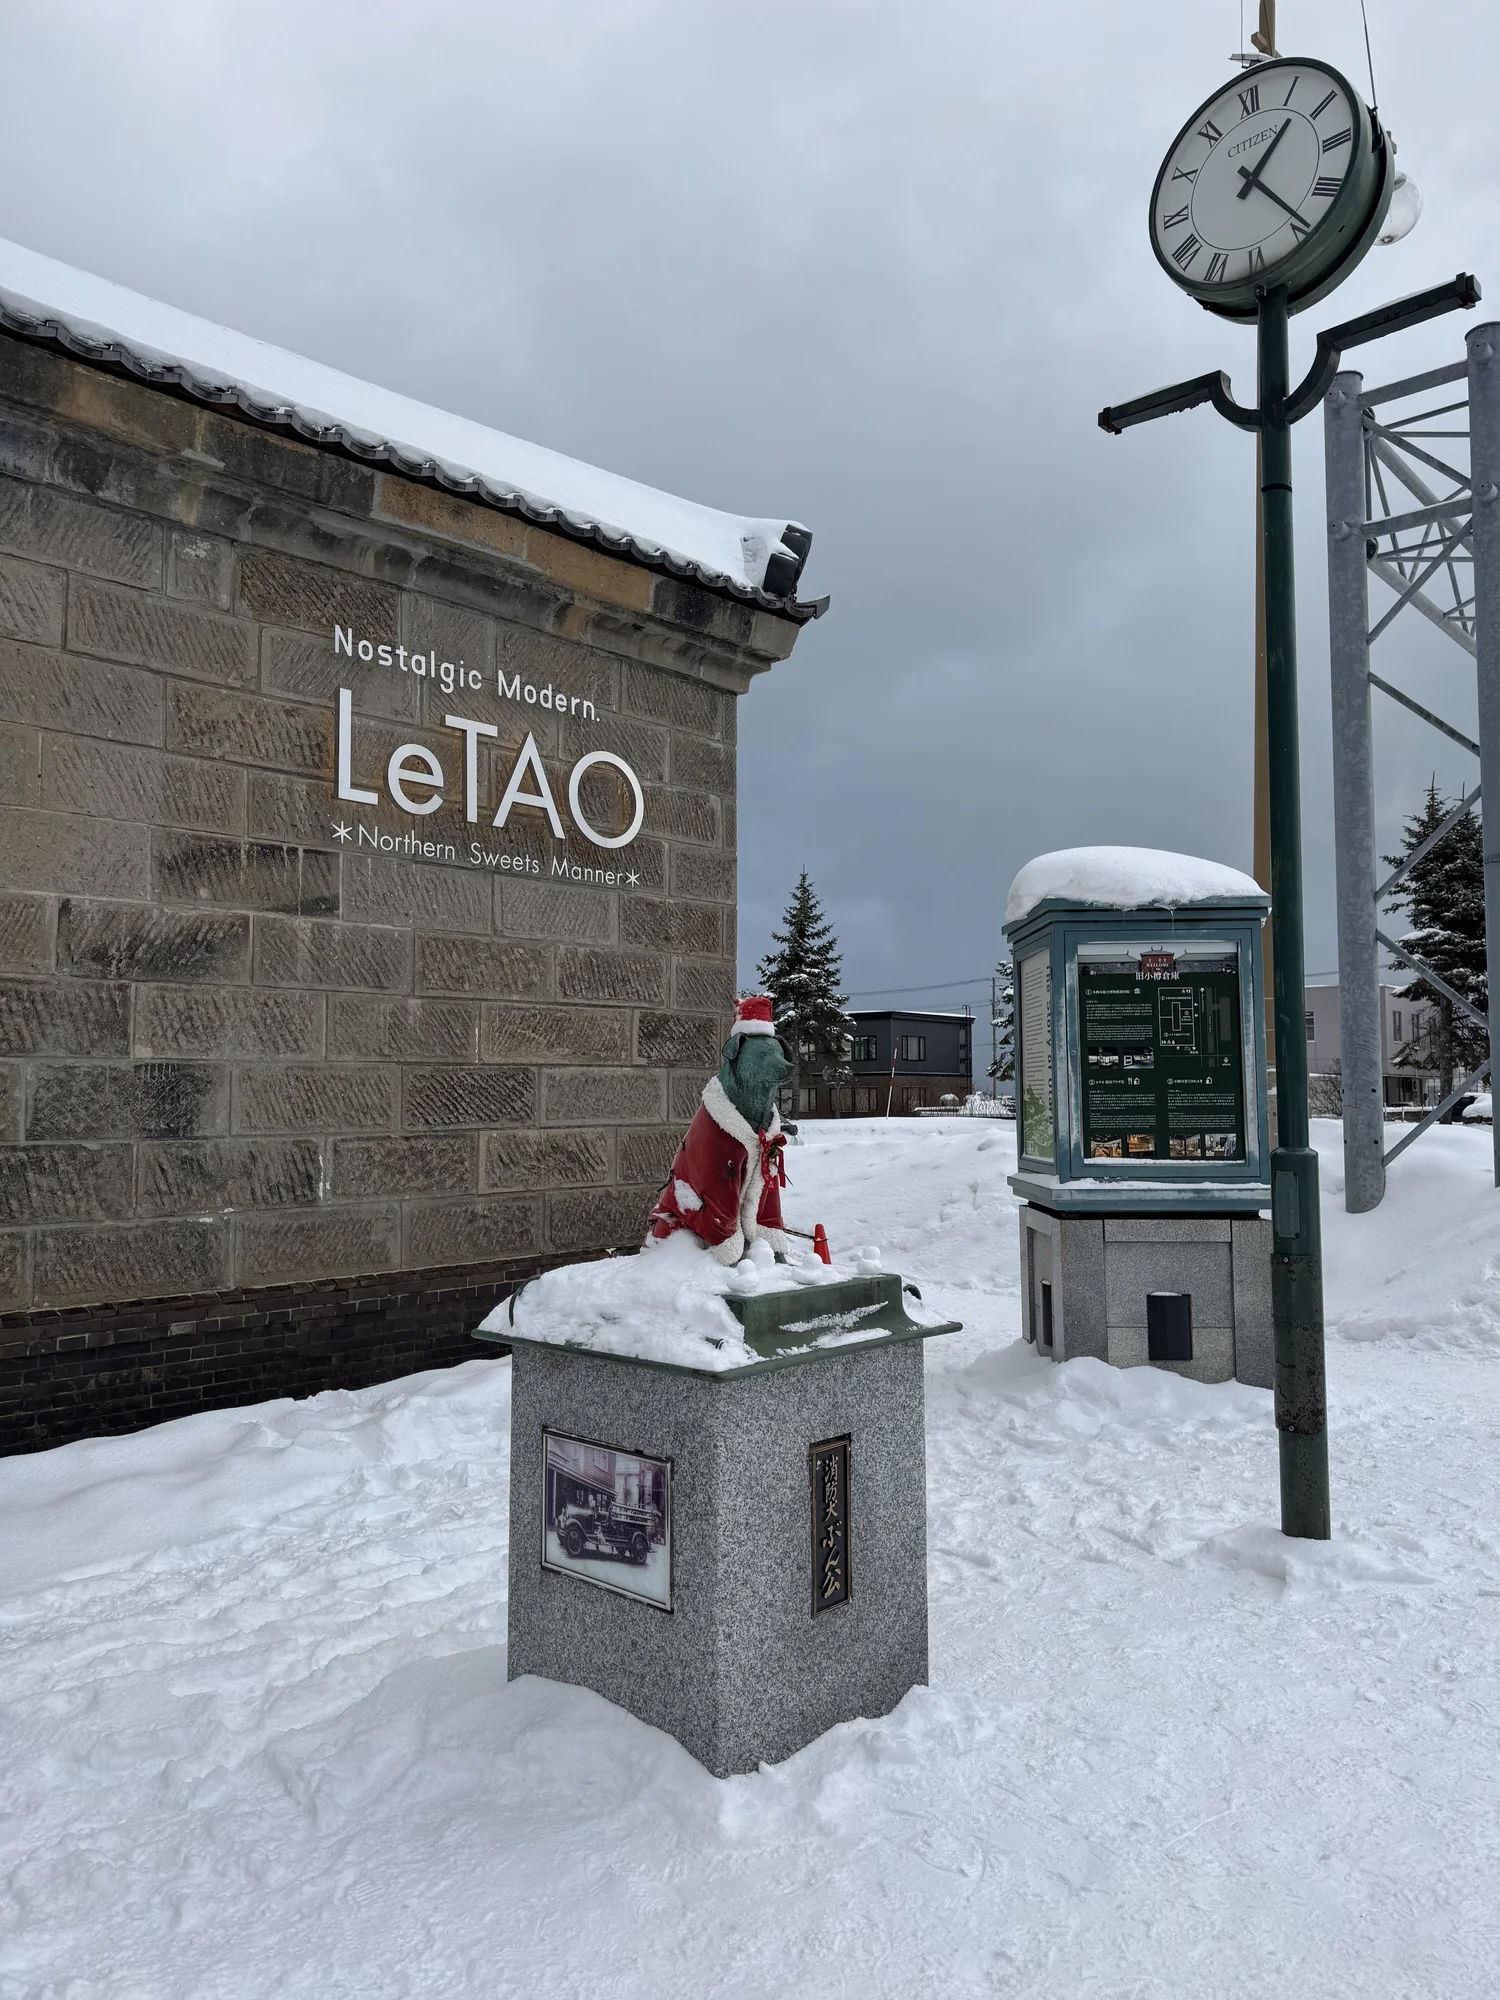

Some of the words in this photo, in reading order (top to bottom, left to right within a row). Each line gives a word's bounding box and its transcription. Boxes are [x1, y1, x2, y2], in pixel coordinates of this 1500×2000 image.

[1237, 84, 1261, 121] XII
[1226, 124, 1279, 159] CITIZEN
[334, 624, 483, 694] Nostalgic
[497, 670, 602, 723] Modern.
[338, 687, 645, 849] LeTAO
[470, 842, 540, 874] Sweets
[1135, 971, 1180, 981] 旧小樽倉庫
[822, 1454, 843, 1600] 消防犬ぶん公
